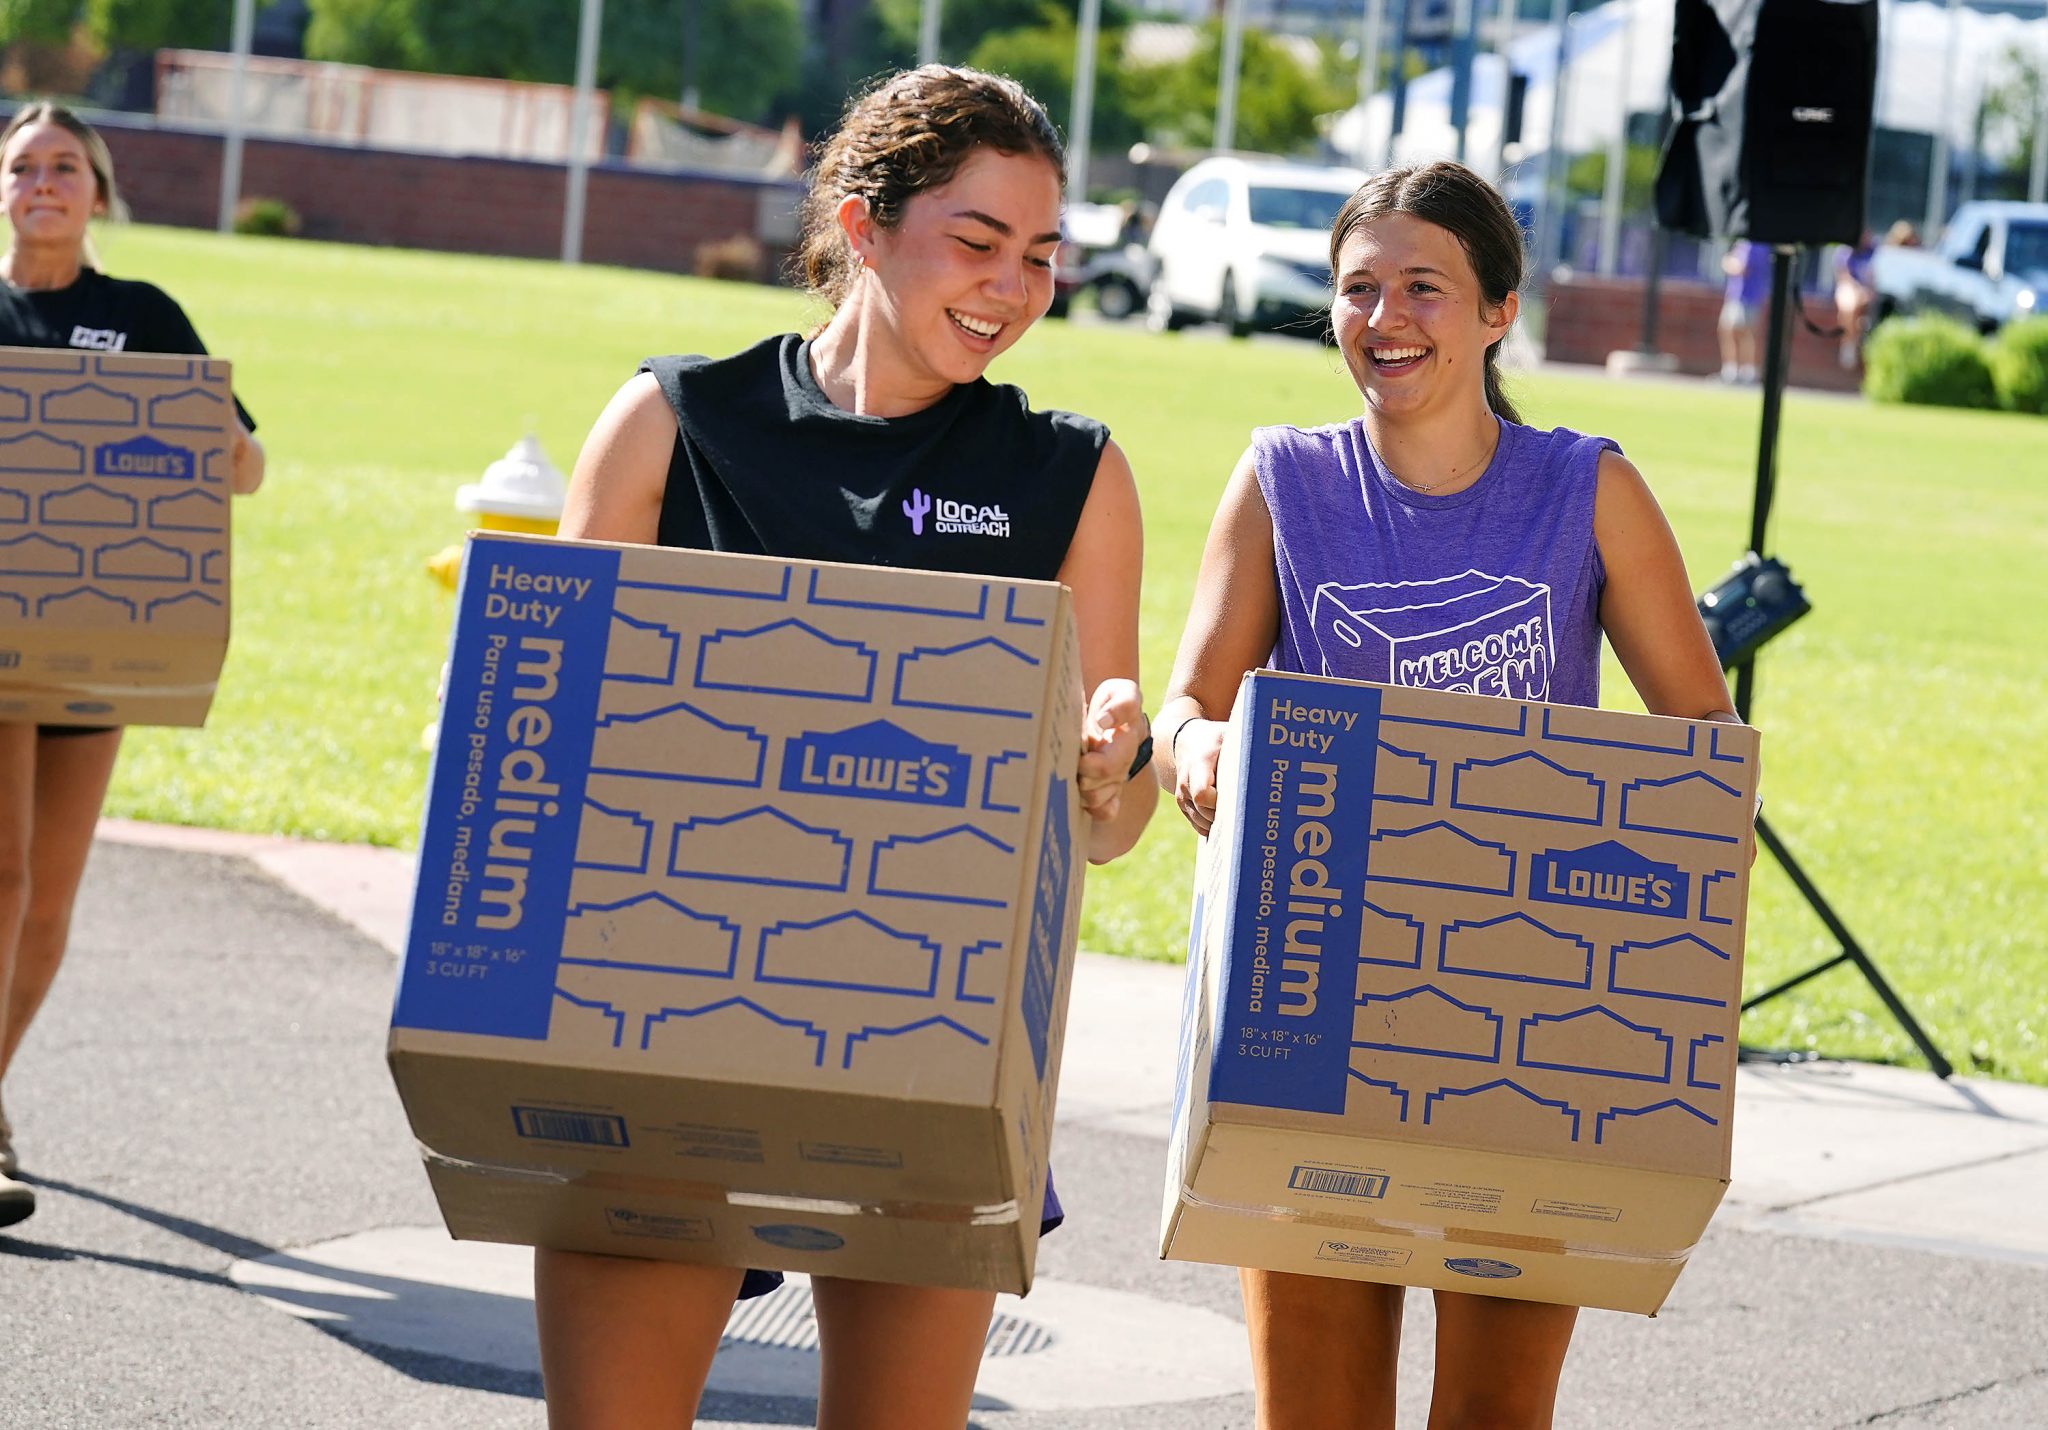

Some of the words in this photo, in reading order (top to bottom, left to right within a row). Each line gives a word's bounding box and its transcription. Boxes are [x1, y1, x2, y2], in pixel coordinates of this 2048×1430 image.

[103, 448, 186, 475] LOWE'S
[935, 521, 1010, 538] OUTREACH
[936, 498, 1009, 523] LOCAL
[489, 564, 592, 601] Heavy
[484, 593, 561, 628] Duty
[481, 634, 508, 686] Para
[1400, 616, 1542, 687] WELCOME
[475, 690, 494, 729] uso
[1270, 698, 1359, 731] Heavy
[1268, 723, 1335, 754] Duty
[455, 733, 487, 821] pesado,
[475, 636, 565, 931] medium
[801, 745, 950, 797] LOWE'S
[1269, 758, 1290, 803] Para
[1265, 807, 1281, 842] uso
[442, 826, 472, 926] mediana
[1255, 845, 1278, 921] pesado,
[1277, 761, 1343, 1017] medium
[1547, 861, 1672, 908] LOWE'S
[426, 960, 436, 976] 3
[440, 962, 465, 978] CU
[468, 963, 488, 979] FT
[1249, 926, 1271, 1013] mediana
[1238, 1044, 1247, 1056] 3
[1250, 1045, 1271, 1058] CU
[1274, 1048, 1291, 1059] FT
[1240, 1027, 1259, 1039] 18"
[1271, 1030, 1290, 1042] 18"
[1303, 1033, 1322, 1045] 16"
